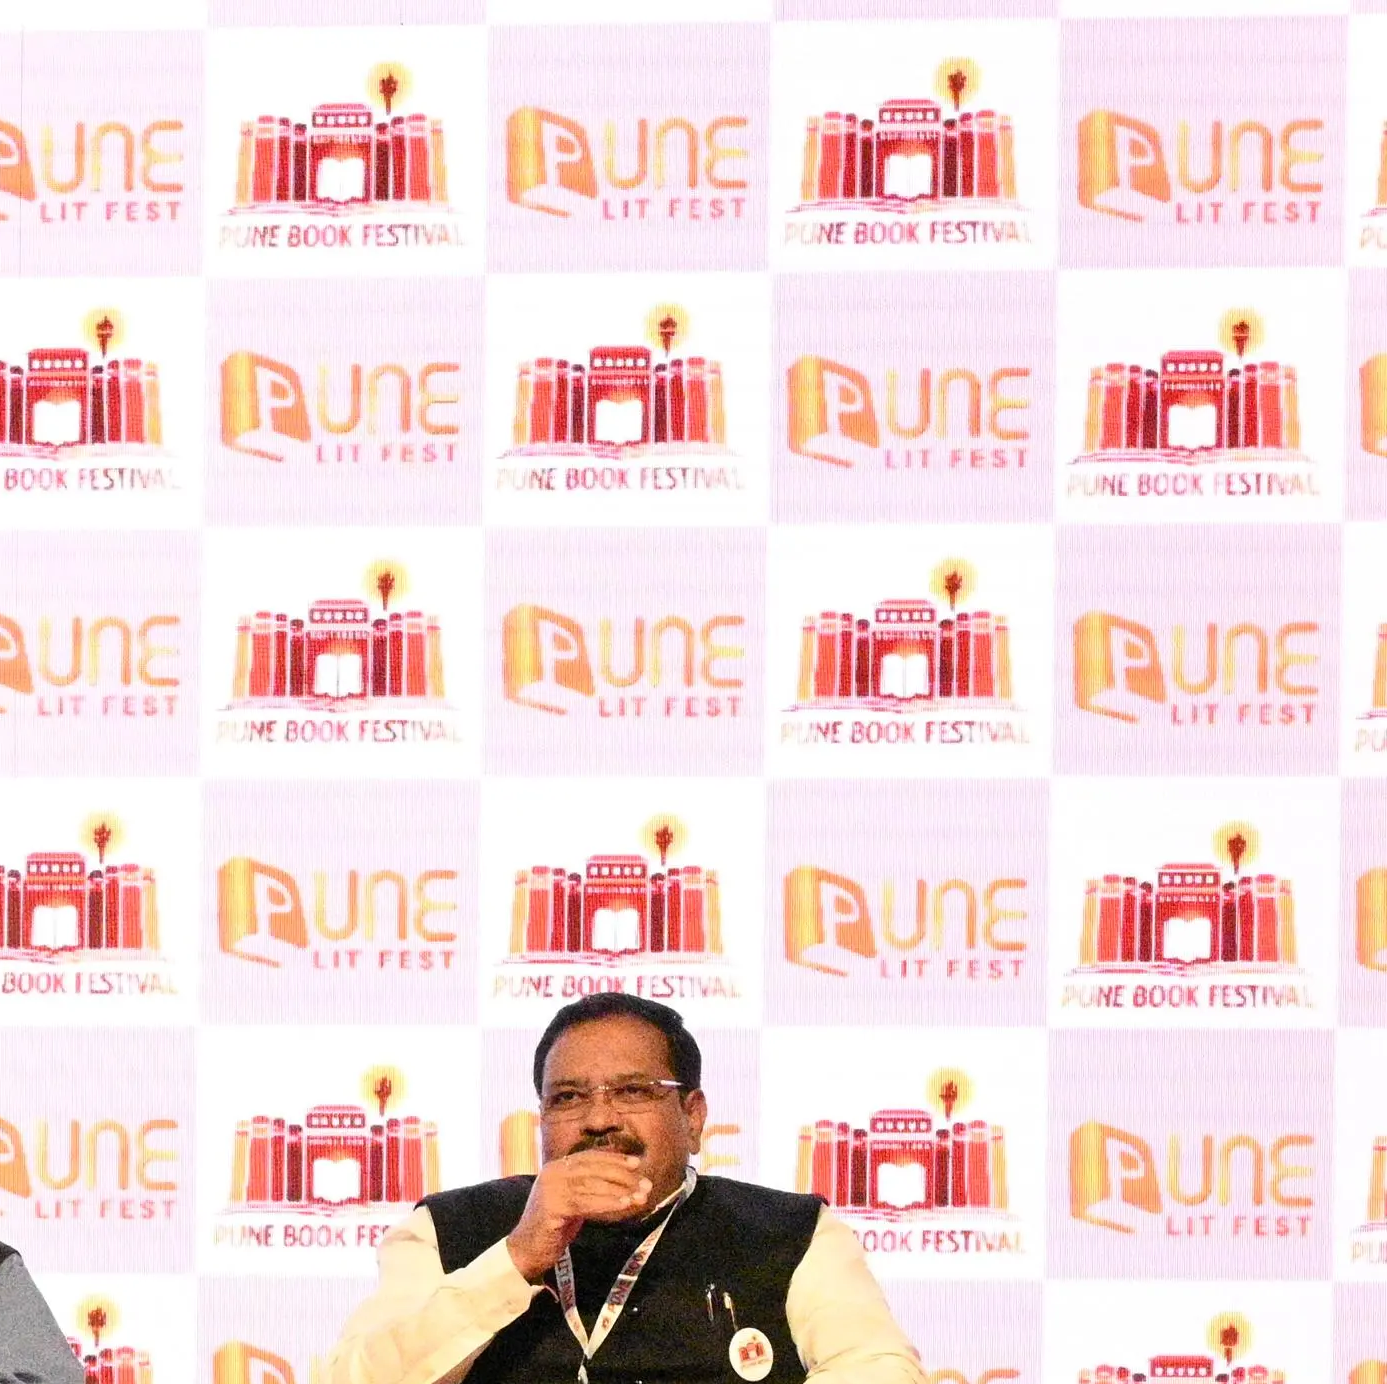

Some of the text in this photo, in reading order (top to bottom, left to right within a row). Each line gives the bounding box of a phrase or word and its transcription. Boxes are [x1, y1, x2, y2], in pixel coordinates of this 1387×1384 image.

[1077, 109, 1324, 209] PUNE
[40, 200, 181, 222] LIT FEST
[1175, 201, 1321, 224] LIT FEST
[854, 220, 921, 245] BOOK
[787, 355, 1031, 455] PUNE
[884, 448, 1027, 469] LIT FEST
[1136, 473, 1204, 497] BOOK
[1073, 612, 1319, 711] PUNE
[1170, 704, 1316, 726] LIT FEST
[283, 719, 350, 743] BOOK
[217, 857, 459, 955] PUNE
[313, 949, 455, 971] LIT FEST
[1069, 1121, 1314, 1222] PUNE
[1167, 1215, 1311, 1238] LIT FEST
